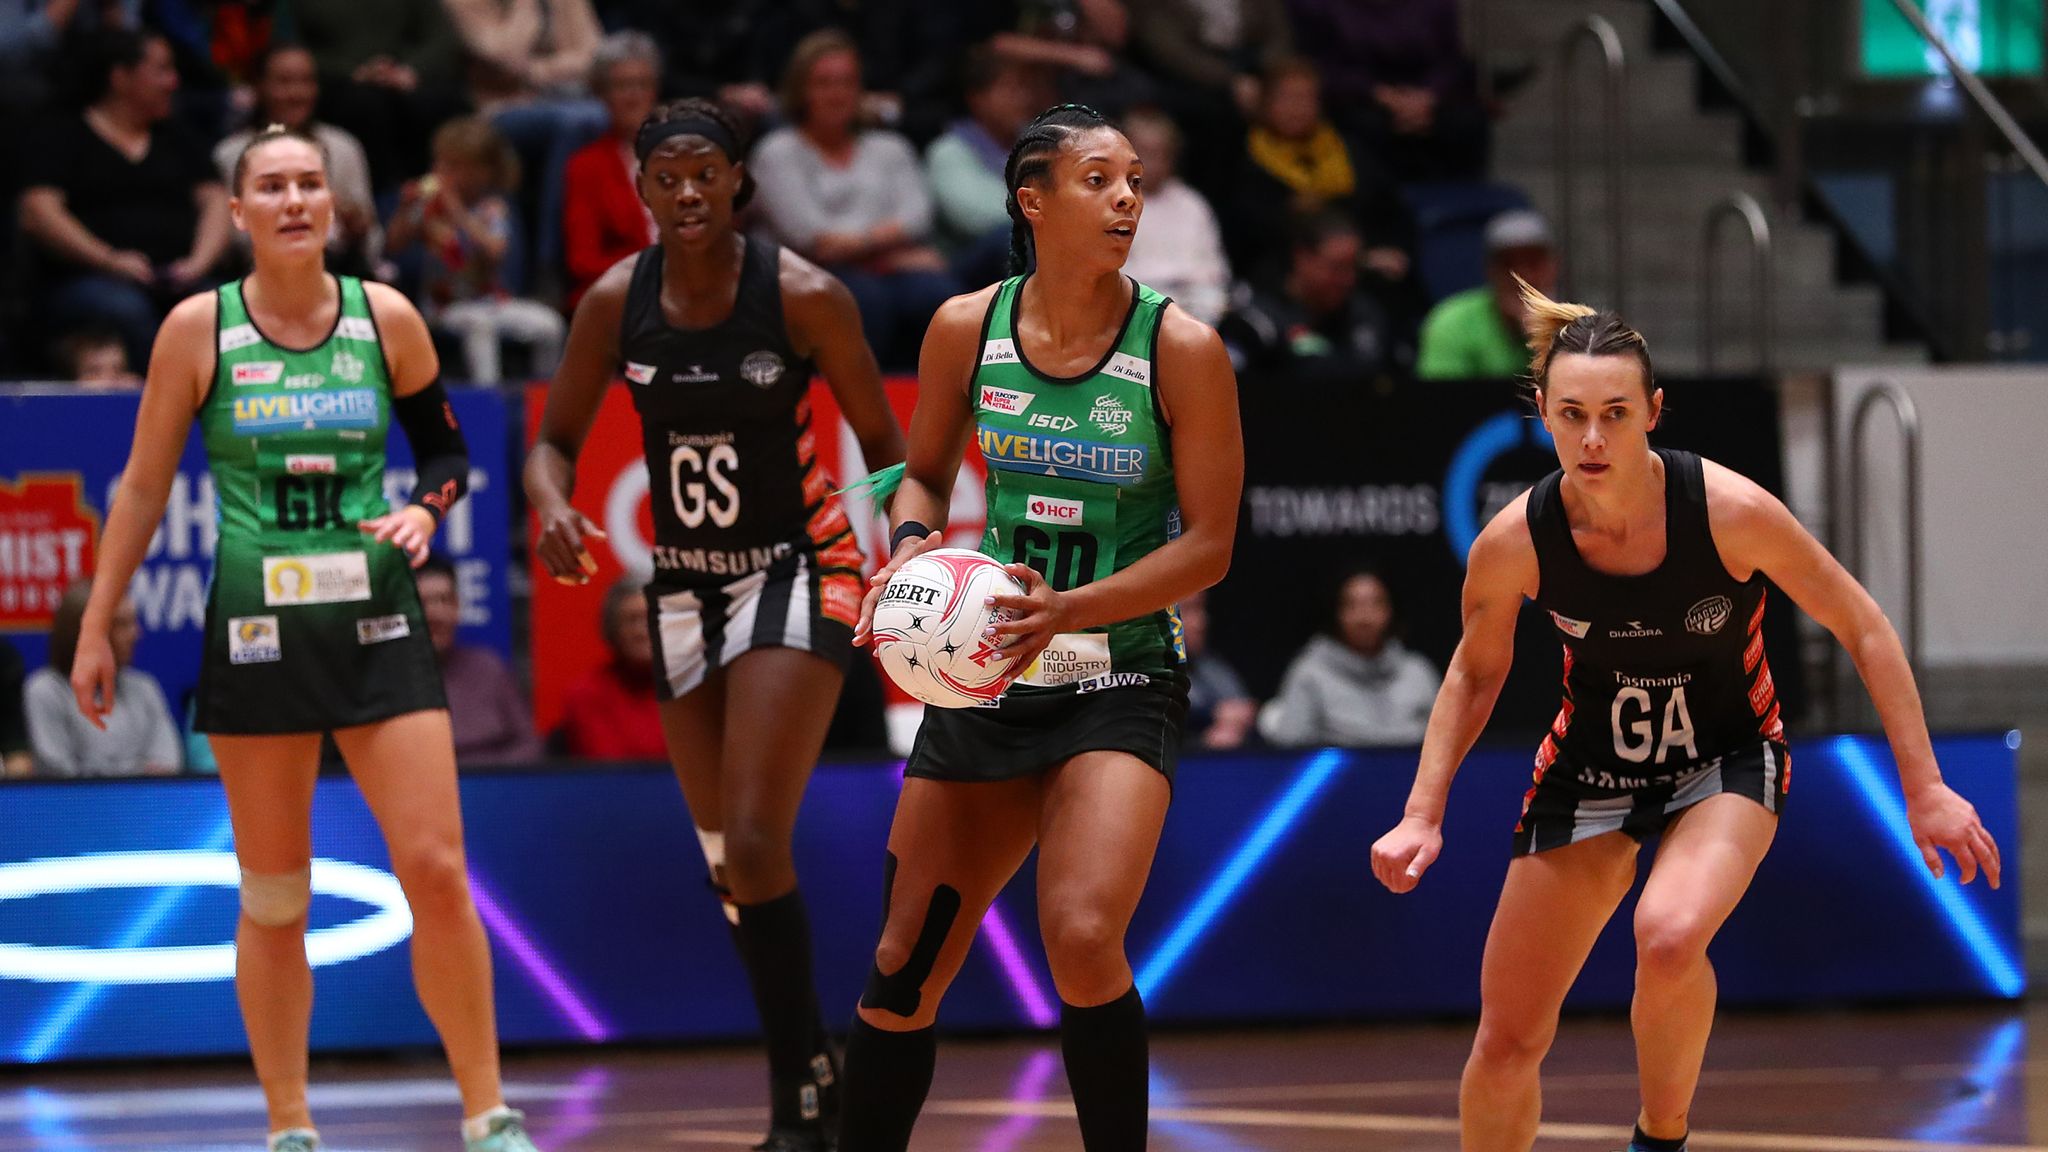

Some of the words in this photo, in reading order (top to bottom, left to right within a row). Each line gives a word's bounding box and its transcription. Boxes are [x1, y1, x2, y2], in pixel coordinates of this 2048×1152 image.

[995, 351, 1014, 361] Bella
[1112, 364, 1123, 374] Di
[1123, 368, 1145, 382] Bella
[235, 388, 377, 422] LIVELIGHTER
[1027, 413, 1064, 430] ISC
[1088, 410, 1132, 423] FEVER
[978, 427, 1143, 472] LIVELIGHTER
[670, 445, 741, 529] GS
[276, 475, 346, 530] GK
[1047, 504, 1079, 519] HCF
[1249, 484, 1439, 537] TOWARDS
[1013, 525, 1099, 592] GD
[880, 583, 941, 606] LBERT
[1609, 628, 1663, 638] DIADORA
[1043, 650, 1076, 662] GOLD
[1043, 660, 1108, 673] INDUSTRY
[1043, 672, 1089, 685] GROUP
[1613, 670, 1692, 688] Tasmania
[1611, 686, 1699, 764] GA
